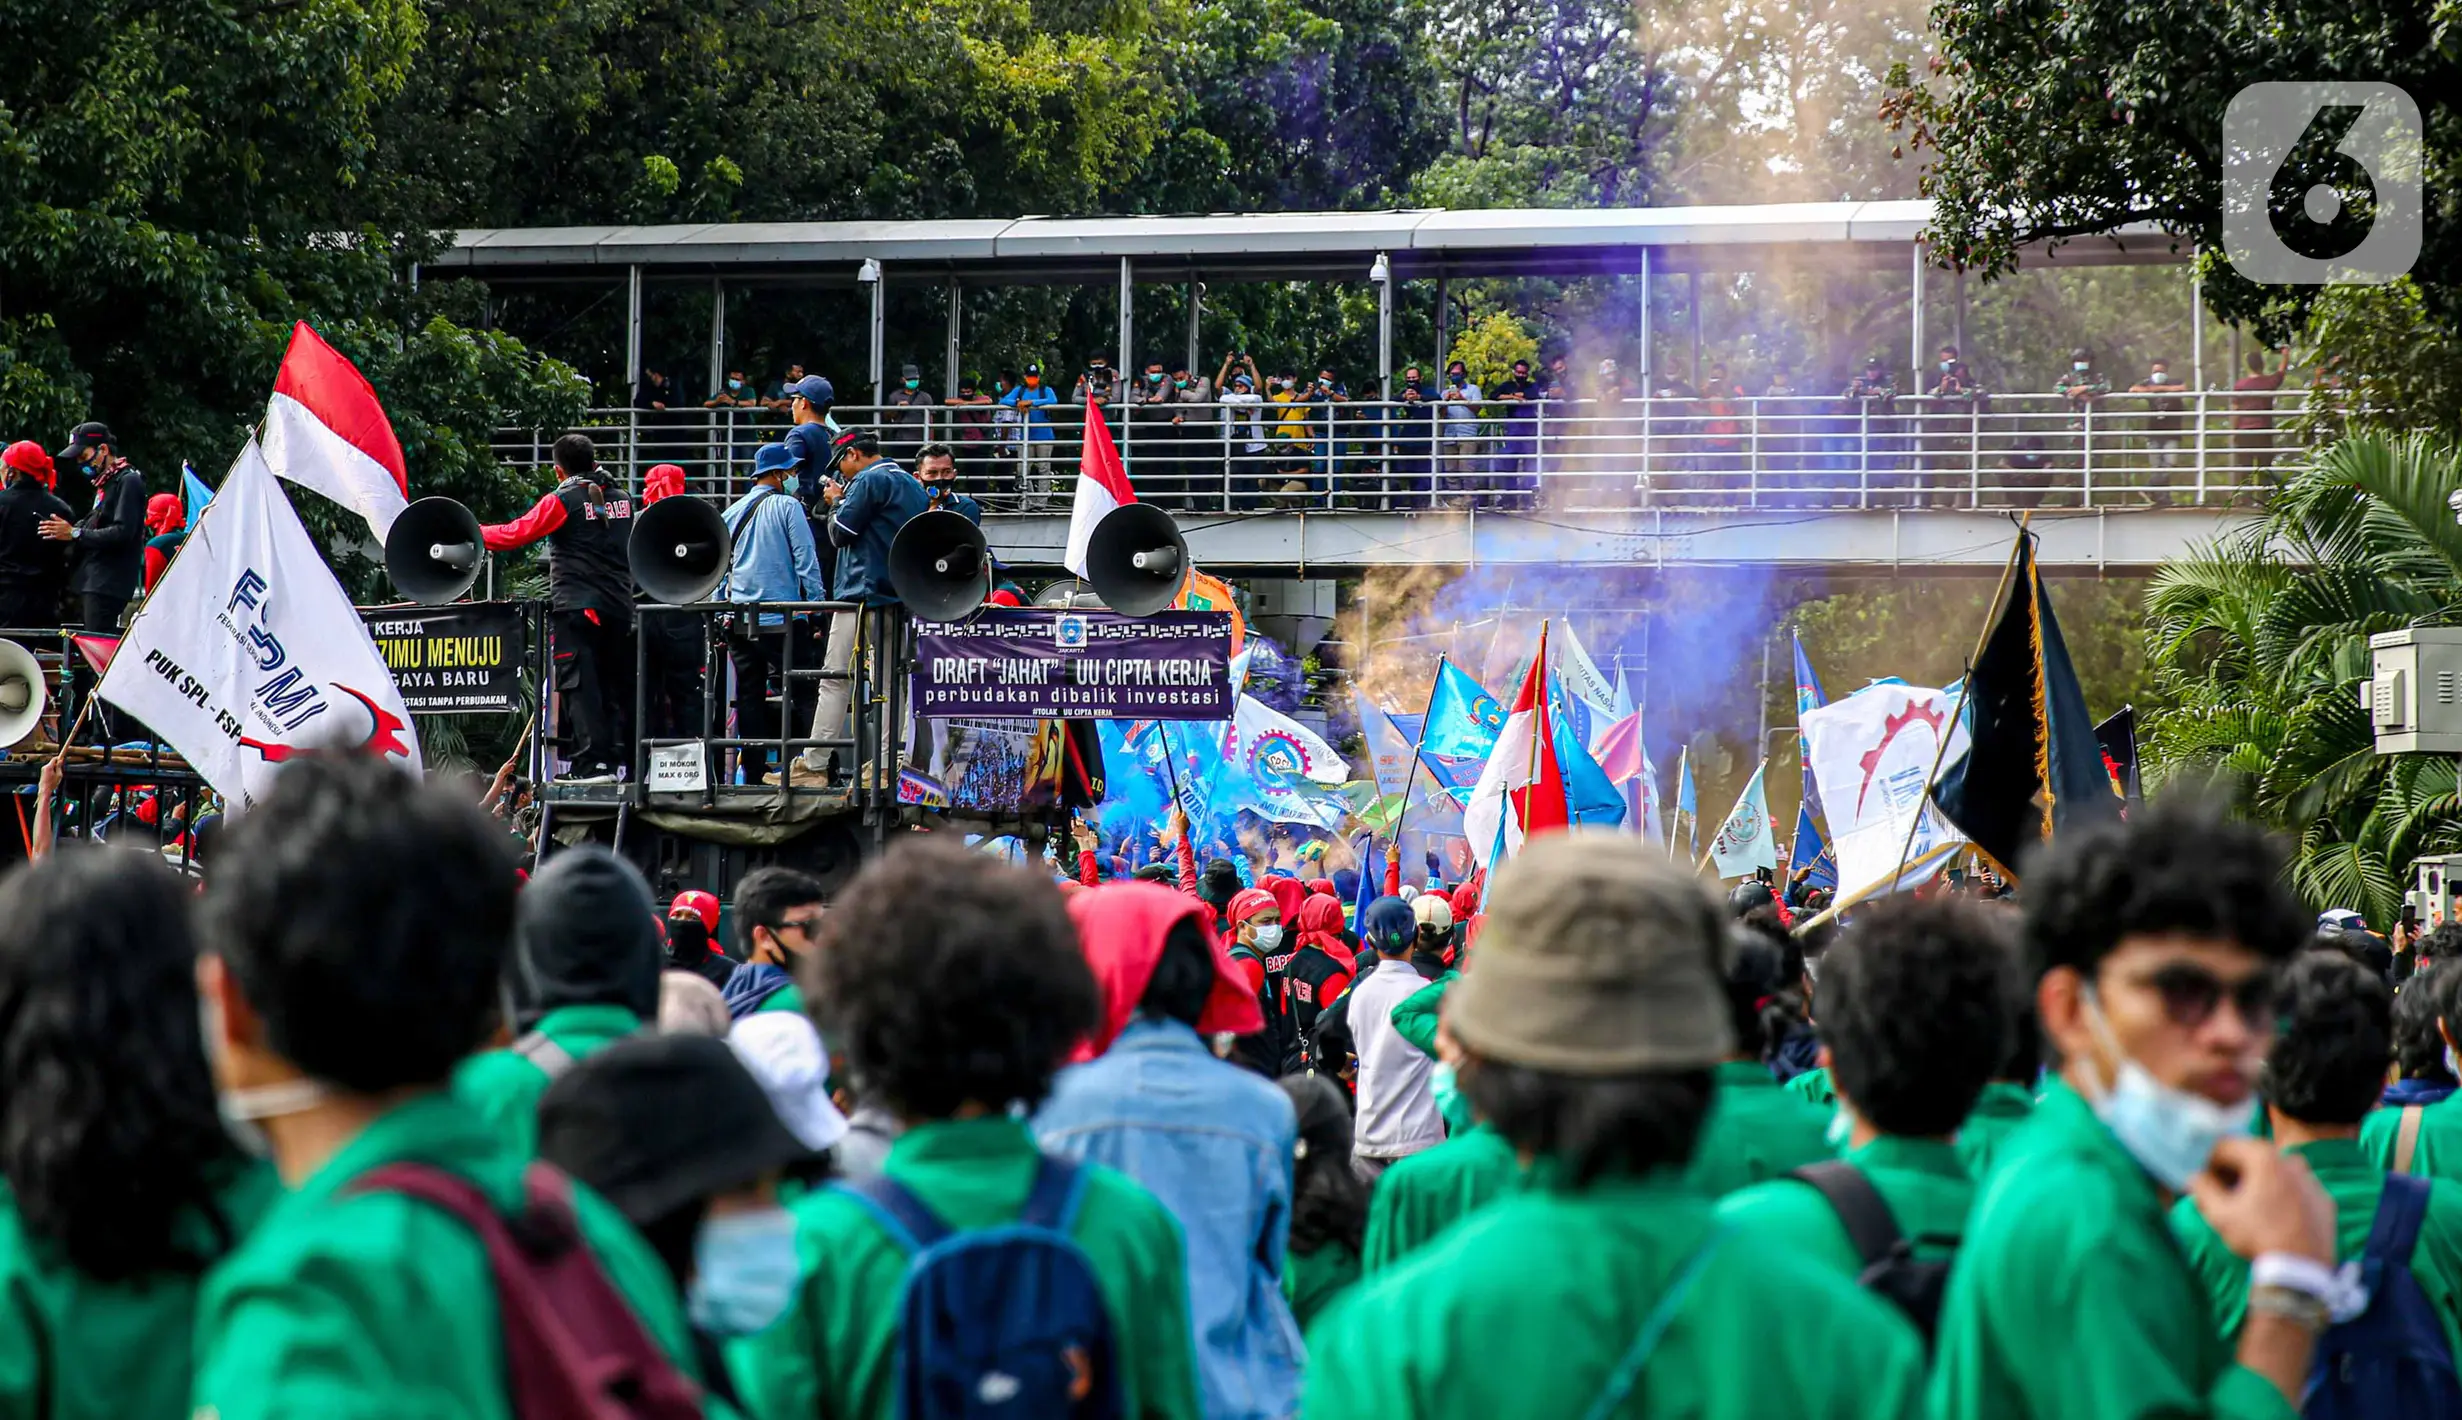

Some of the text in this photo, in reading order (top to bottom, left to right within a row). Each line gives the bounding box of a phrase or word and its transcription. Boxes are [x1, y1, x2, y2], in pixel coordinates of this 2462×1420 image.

[216, 612, 248, 646] FEDERASI
[375, 621, 424, 636] KERJA
[374, 635, 501, 669] ZIMU MENUJU
[144, 648, 184, 685] PUK
[178, 675, 212, 710] SPL
[442, 670, 490, 687] BARU
[933, 657, 988, 685] DRAFT
[1076, 658, 1100, 686] UU
[1105, 657, 1154, 686] CIPTA
[1158, 658, 1213, 687] KERJA
[428, 696, 454, 706] TANPA
[455, 694, 507, 706] PERBUDAKAN
[925, 686, 1220, 706] perbudakan dibalik investasi
[1032, 708, 1113, 717] #TOLAK UU CIPTA KERJA
[255, 708, 283, 738] INDONESIA
[658, 770, 700, 779] MAX 6 ORG
